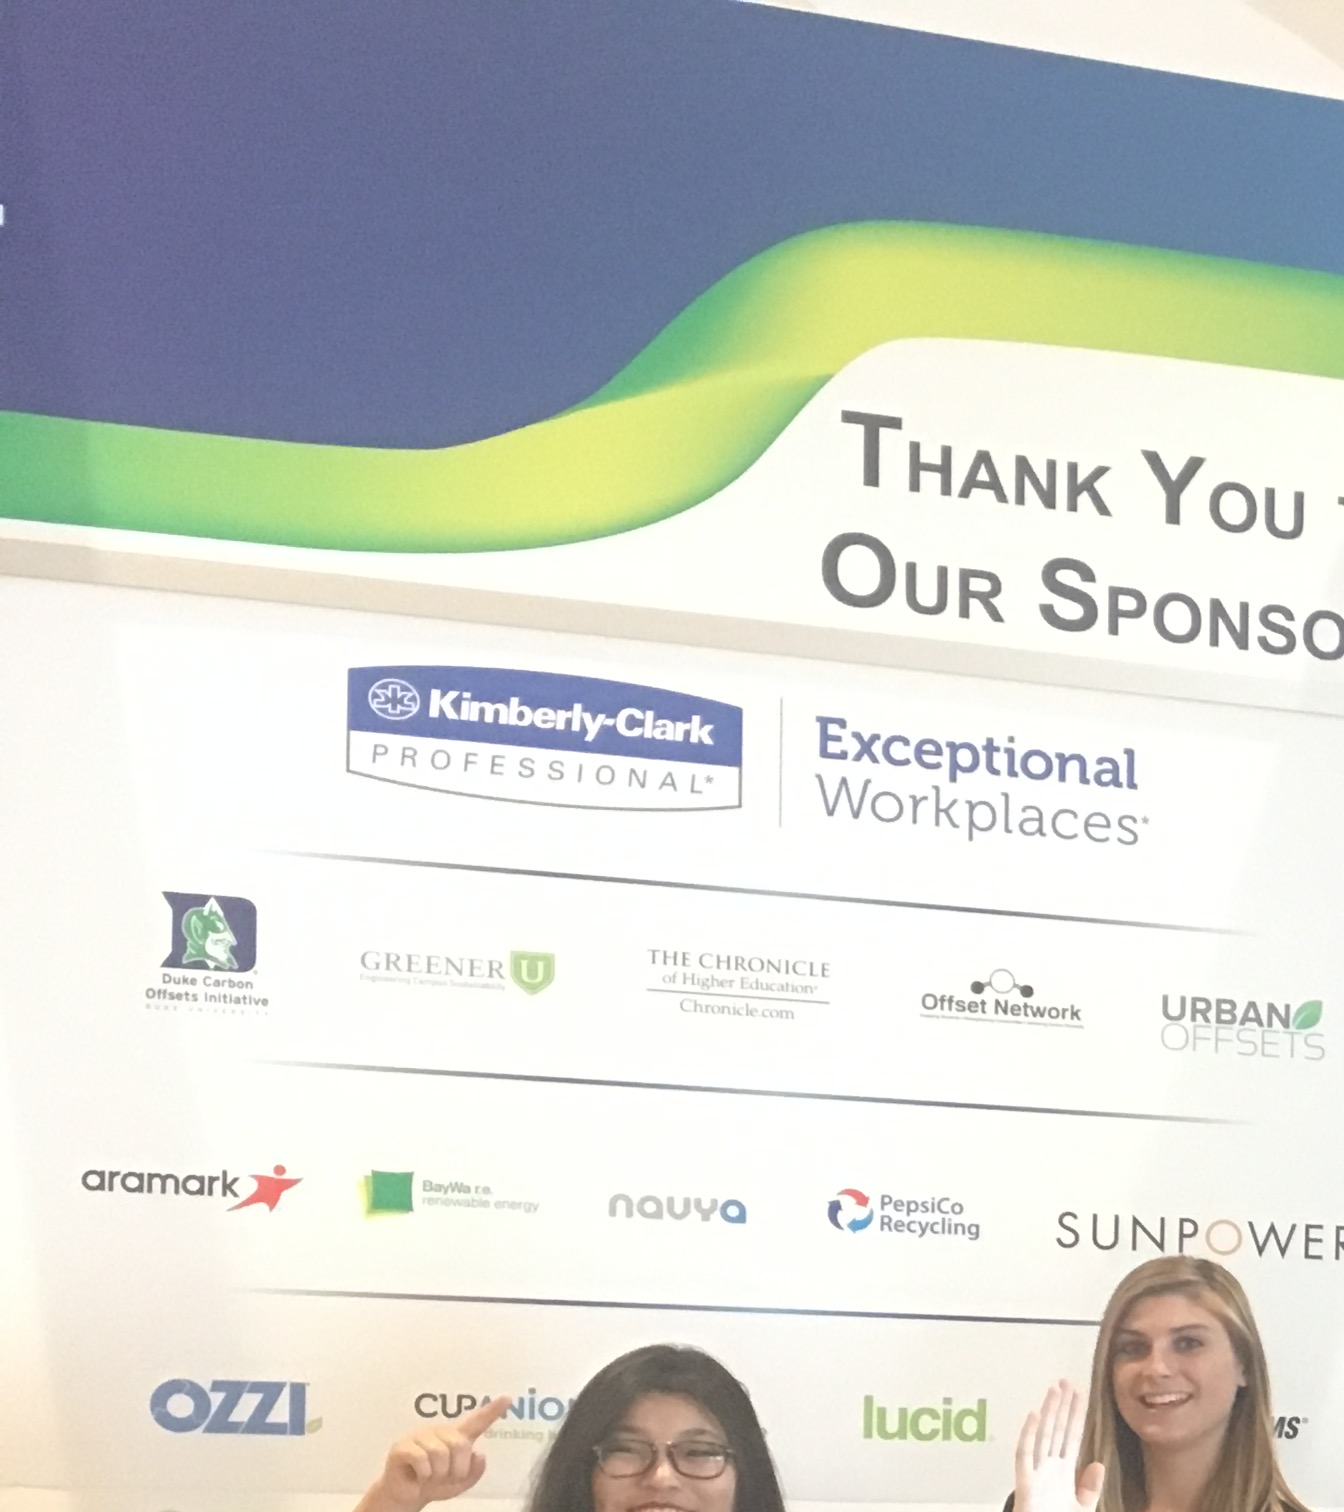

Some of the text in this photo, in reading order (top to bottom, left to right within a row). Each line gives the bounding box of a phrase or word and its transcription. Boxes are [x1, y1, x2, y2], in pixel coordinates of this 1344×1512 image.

[428, 688, 715, 746] Kimberly-Clark
[815, 714, 1139, 791] Exceptional
[360, 950, 507, 980] GREENER
[647, 949, 831, 978] THE CHRONICLE
[162, 972, 254, 990] Duke Carbon
[662, 972, 678, 985] of
[682, 972, 735, 991] Higher
[145, 988, 269, 1007] Offsets Initiative
[679, 998, 796, 1021] Chronicle.com
[921, 993, 988, 1015] Offset
[994, 998, 1082, 1022] Network
[1161, 993, 1291, 1030] URBAN
[1161, 1022, 1326, 1062] OFFSETS
[81, 1169, 241, 1199] aramark
[494, 1199, 540, 1214] energy
[880, 1194, 965, 1217] PepsiCo
[880, 1214, 981, 1241] Recycling
[150, 1378, 307, 1437] OZZI
[863, 1395, 988, 1442] lucid
